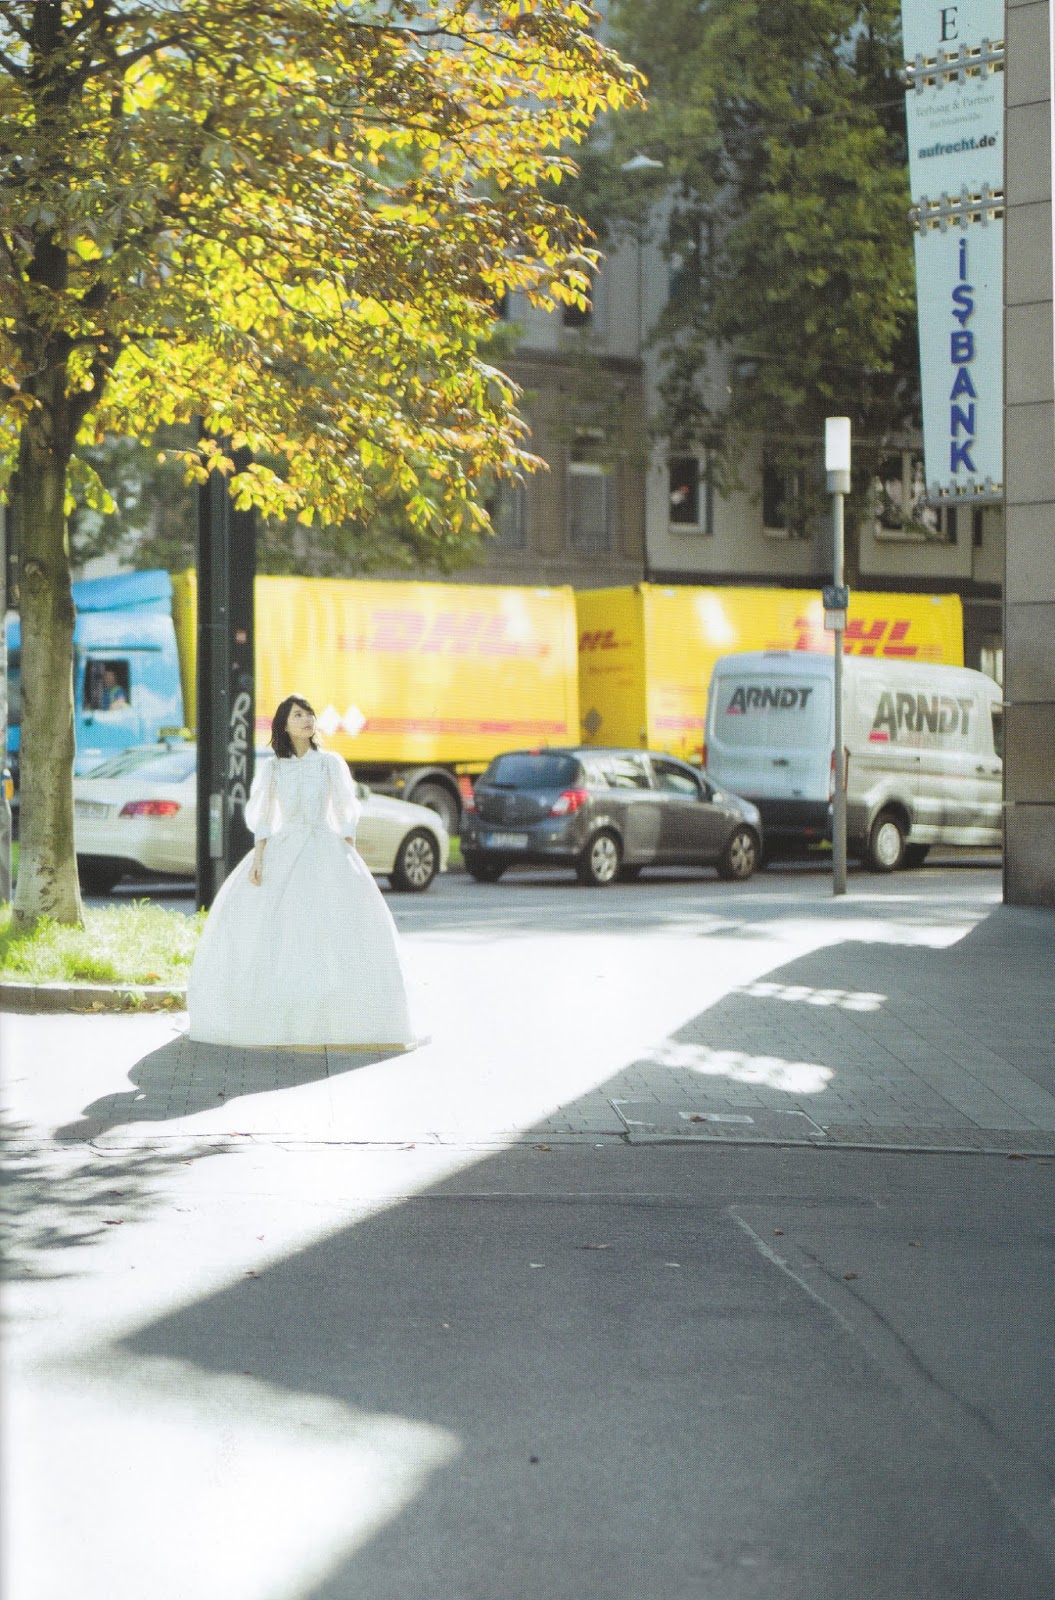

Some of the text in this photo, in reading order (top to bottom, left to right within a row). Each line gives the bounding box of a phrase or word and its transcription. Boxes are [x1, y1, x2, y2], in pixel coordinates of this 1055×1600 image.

[938, 6, 958, 42] E
[918, 134, 996, 159] aufrecht.de
[370, 609, 520, 656] DHL
[727, 686, 813, 714] ARNDT
[870, 691, 974, 742] ARNDT
